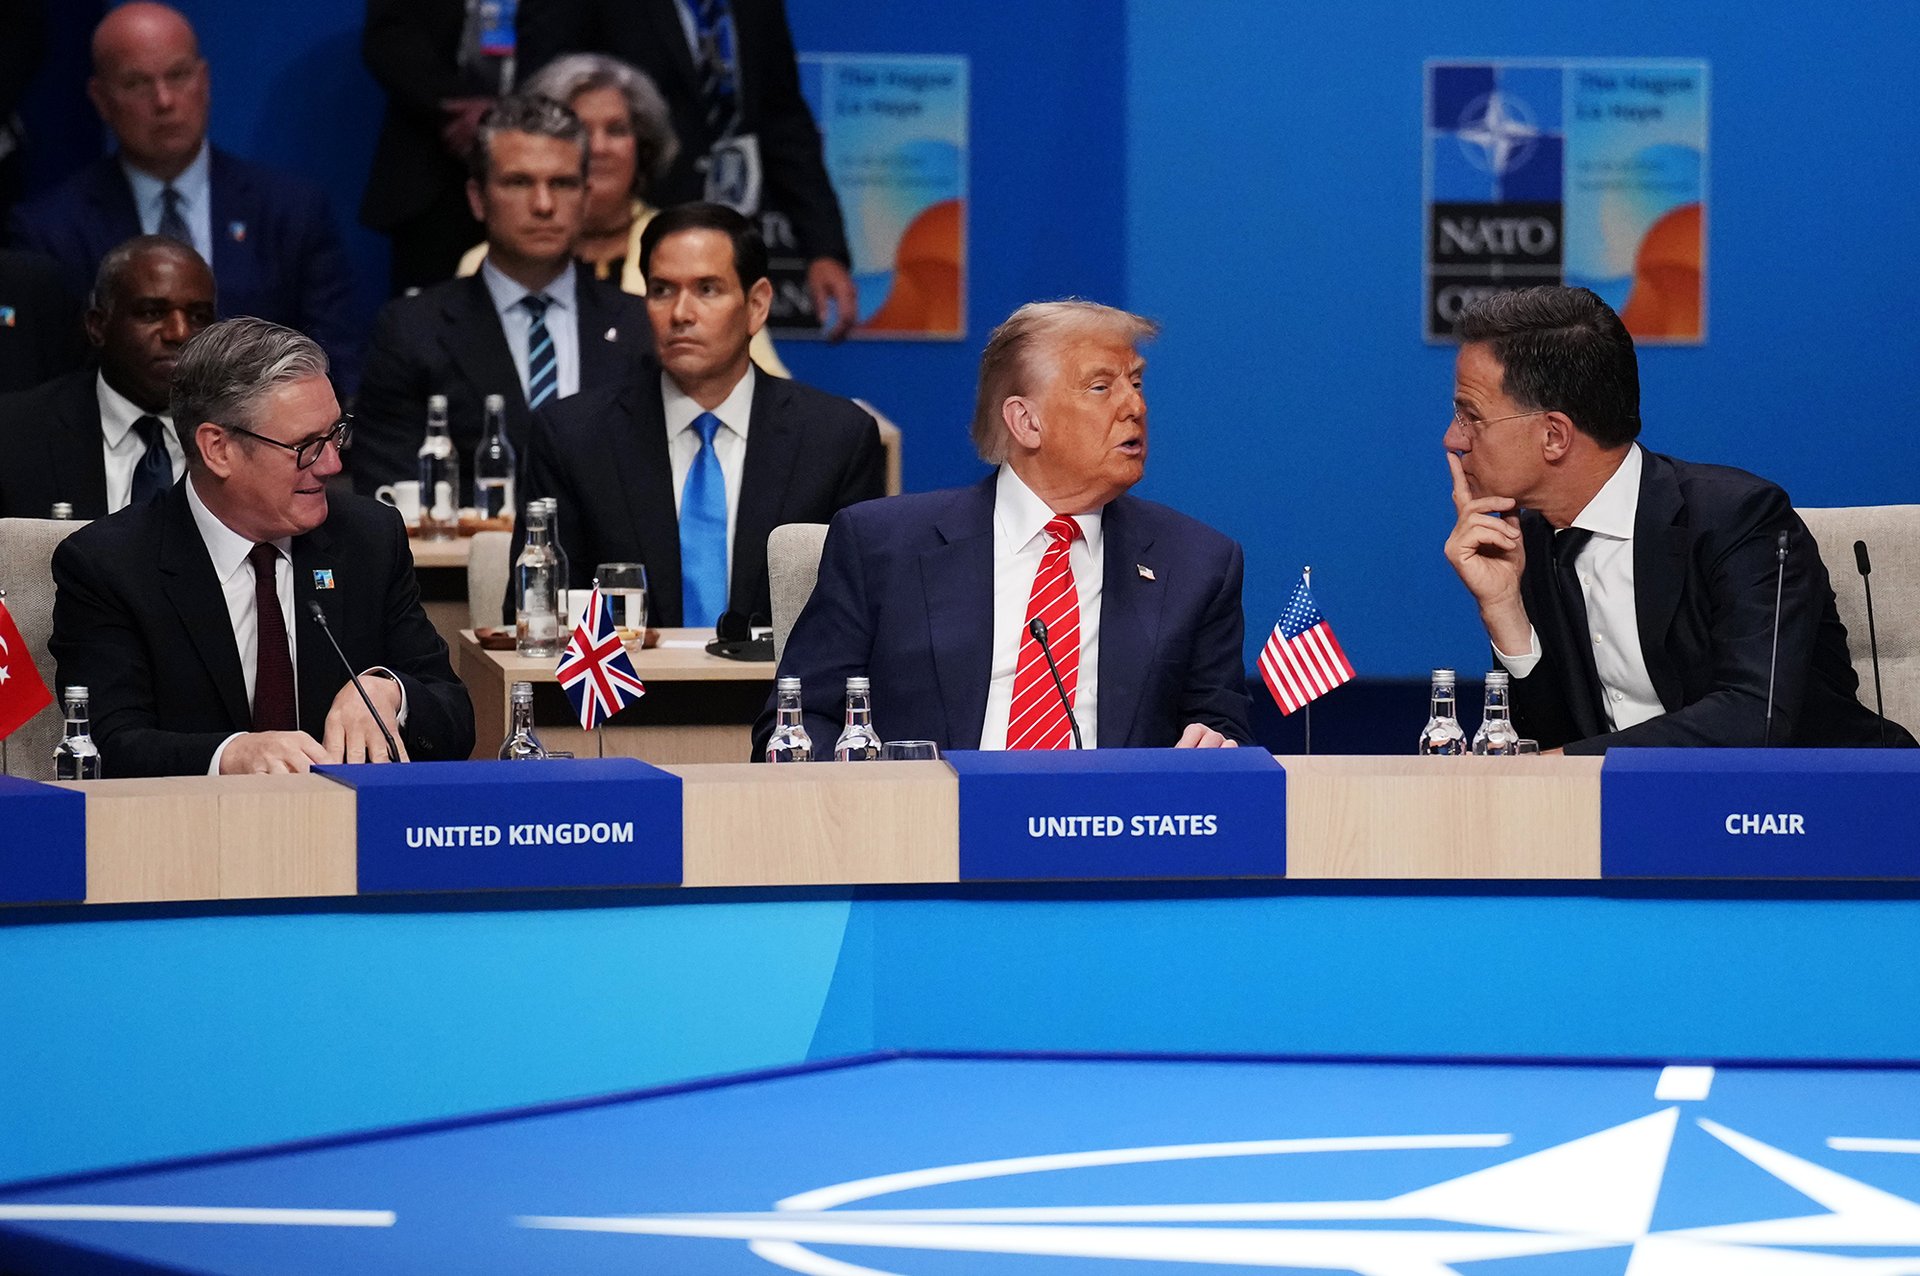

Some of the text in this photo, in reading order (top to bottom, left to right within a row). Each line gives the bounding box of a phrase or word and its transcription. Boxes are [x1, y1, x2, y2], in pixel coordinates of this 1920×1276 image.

[1438, 217, 1557, 256] NATO
[406, 822, 634, 848] UNITED KINGDOM
[1029, 814, 1218, 838] UNITED STATES
[1725, 813, 1806, 835] CHAIR
